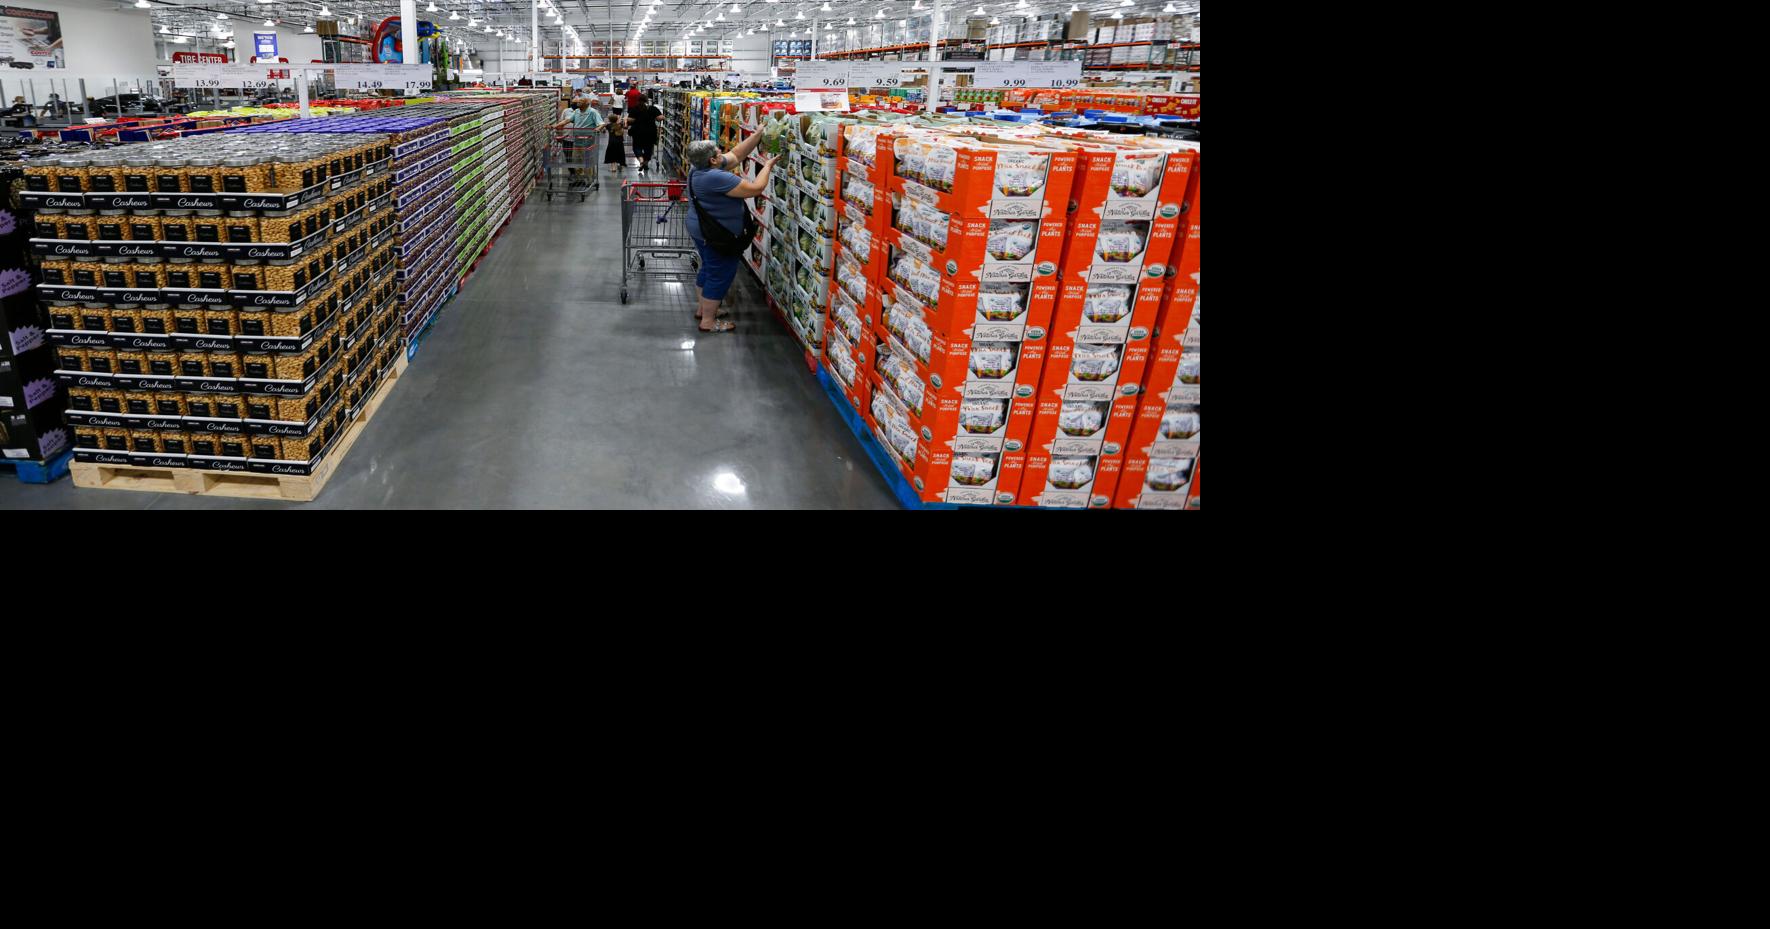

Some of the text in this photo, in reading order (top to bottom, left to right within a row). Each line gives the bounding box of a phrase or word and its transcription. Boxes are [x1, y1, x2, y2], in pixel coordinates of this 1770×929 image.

[46, 198, 81, 207] Cashews
[112, 198, 148, 206] Cashews
[178, 198, 213, 207] Cashews
[243, 199, 280, 208] Cashews
[55, 245, 89, 254] Cashews
[118, 246, 153, 255] Cashews
[183, 247, 219, 256] Cashews
[248, 248, 285, 257] Cashews
[61, 291, 95, 300] Cashews
[123, 293, 157, 301] Cashews
[187, 294, 222, 303] Cashews
[254, 296, 290, 305] Cashews
[71, 336, 105, 345] Cashews
[132, 339, 166, 347] Cashews
[195, 340, 230, 348] Cashews
[260, 342, 296, 350] Cashews
[78, 377, 111, 386] Cashews
[139, 380, 172, 389] Cashews
[200, 382, 234, 391] Cashews
[264, 384, 299, 393] Cashews
[88, 417, 121, 426] Cashews
[147, 420, 180, 428] Cashews
[206, 423, 240, 431] Cashews
[269, 426, 302, 435] Cashews
[95, 454, 128, 463] Cashews
[152, 458, 185, 466] Cashews
[211, 461, 245, 470] Cashews
[272, 464, 305, 474] Cashews
